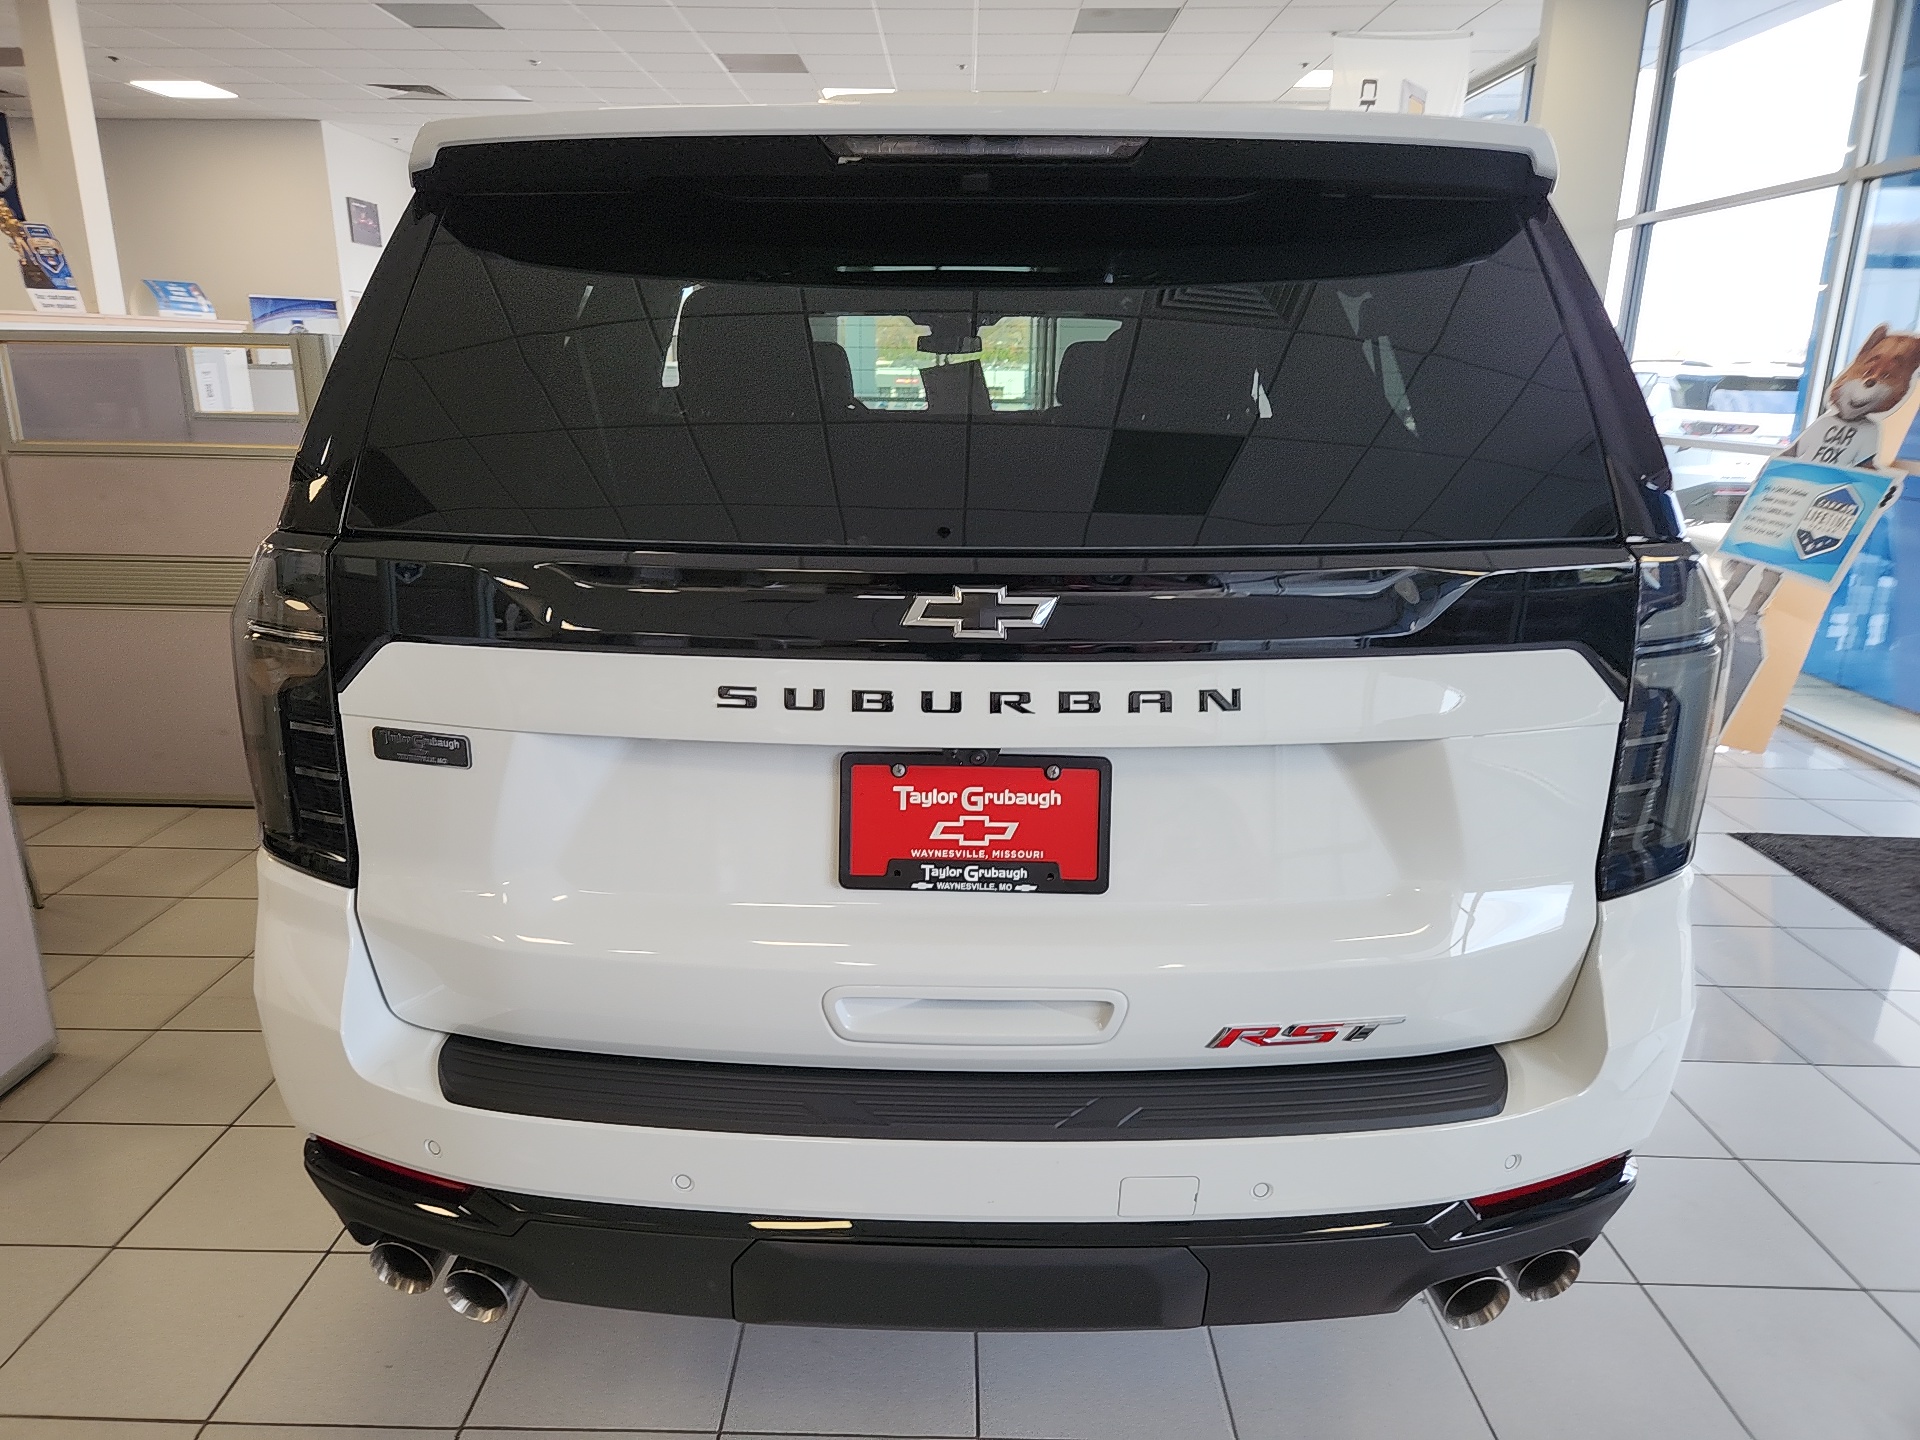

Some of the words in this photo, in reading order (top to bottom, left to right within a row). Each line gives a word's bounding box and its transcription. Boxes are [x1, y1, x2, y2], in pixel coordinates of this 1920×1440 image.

[1823, 425, 1858, 446] CAR
[1811, 446, 1847, 464] FOX
[716, 685, 1242, 715] SUBURBAN
[892, 785, 958, 811] Taylor
[961, 786, 1062, 812] Grubaugh
[910, 849, 989, 860] WAYNESVILLE,
[992, 850, 1044, 859] MISSOURI
[921, 863, 963, 881] Taylor
[964, 865, 1028, 882] Grubaugh
[936, 882, 997, 892] WAYNESVILLE,
[999, 883, 1013, 891] MO
[1204, 1015, 1407, 1049] RST
